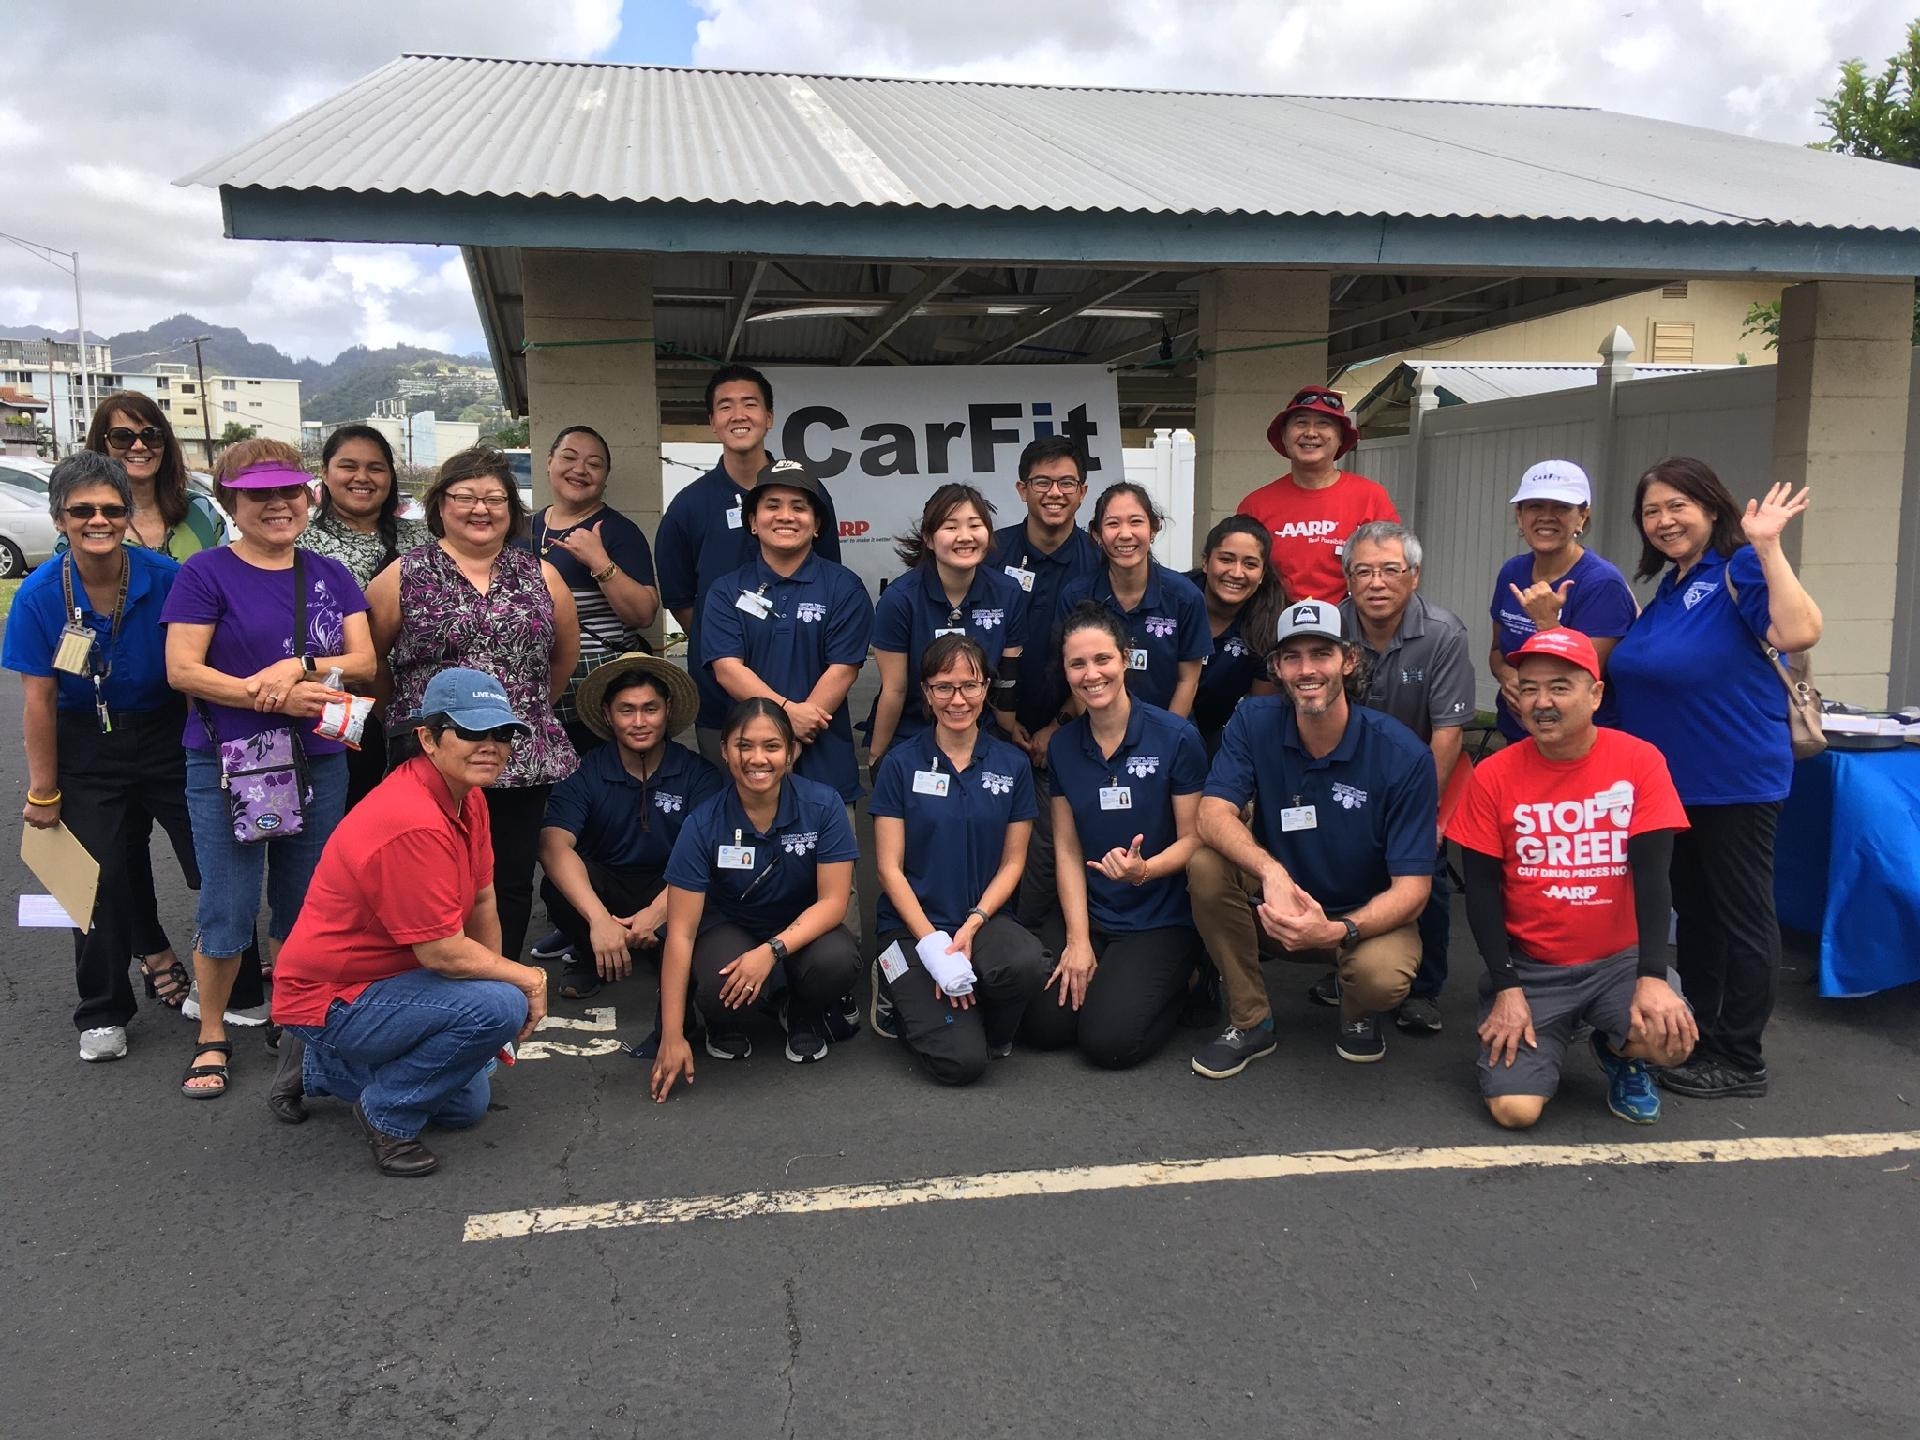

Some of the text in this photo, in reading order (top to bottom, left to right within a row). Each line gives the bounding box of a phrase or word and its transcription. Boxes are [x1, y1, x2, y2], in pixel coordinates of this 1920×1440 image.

[782, 402, 1102, 479] CarFit
[1275, 520, 1337, 538] AARP
[1513, 798, 1608, 835] STOP
[1516, 831, 1628, 866] GREED
[1517, 866, 1628, 878] CUT DRUG PRICES NO
[1543, 885, 1598, 900] AARP
